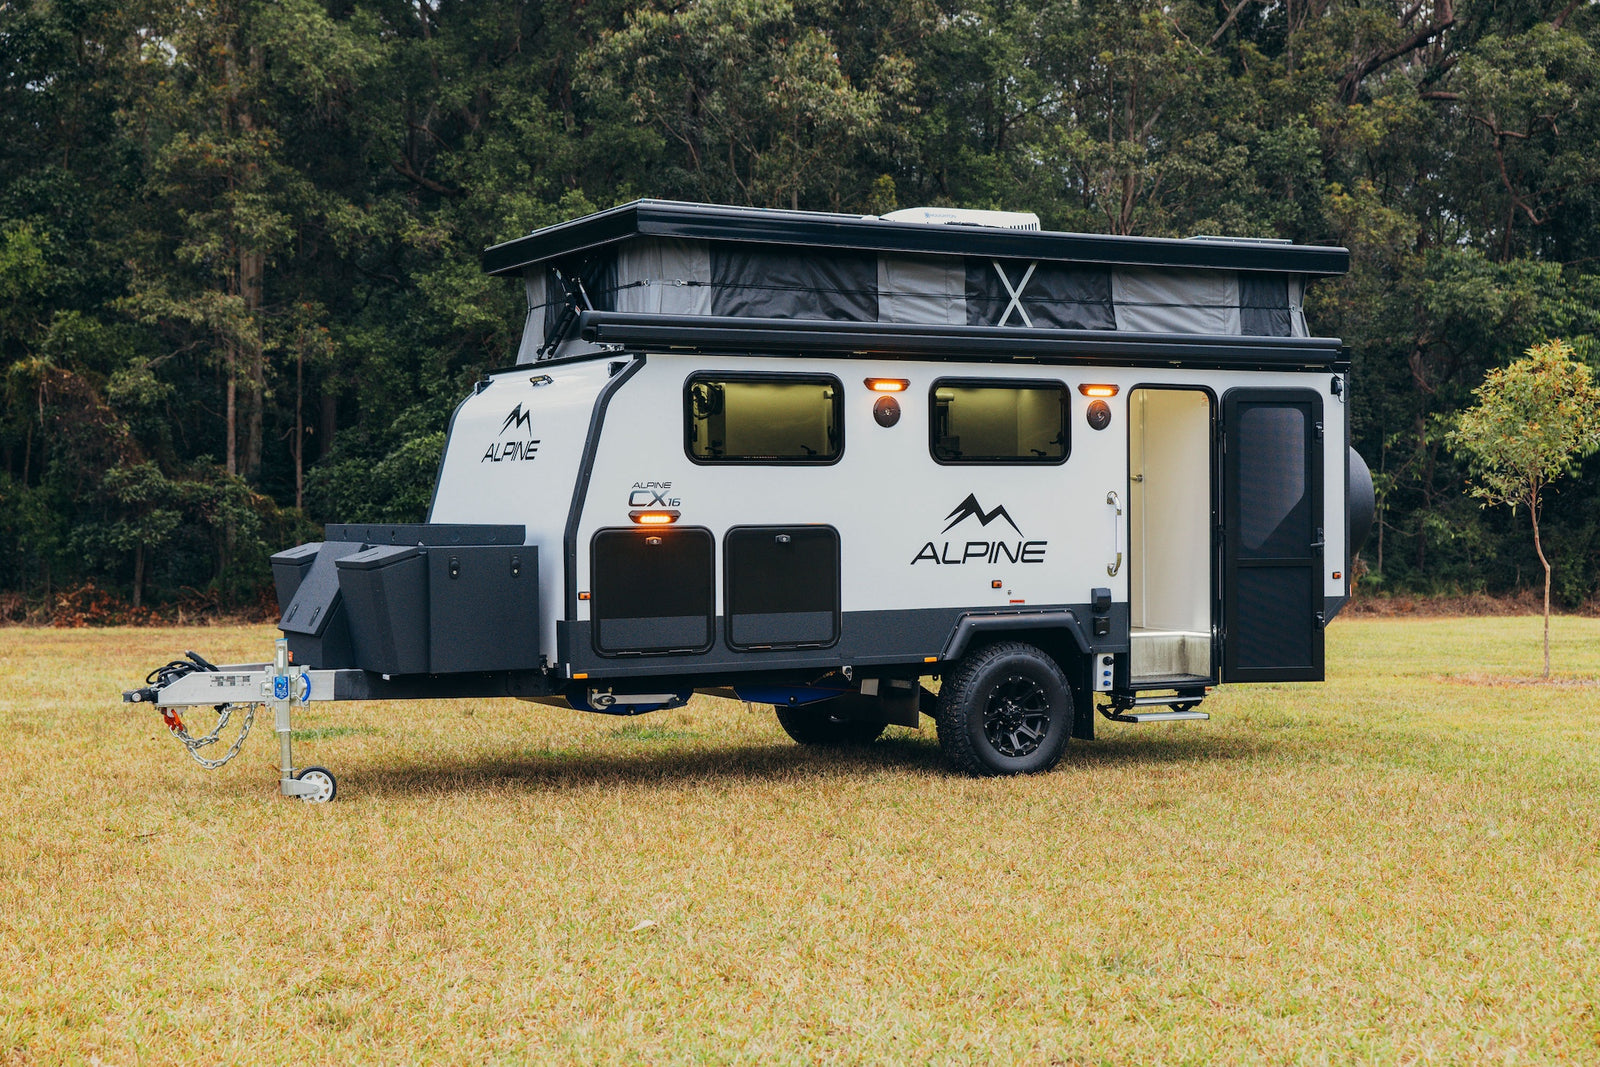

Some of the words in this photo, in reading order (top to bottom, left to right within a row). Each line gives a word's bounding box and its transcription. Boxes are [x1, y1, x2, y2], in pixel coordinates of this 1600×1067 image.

[481, 440, 541, 463] ALPINE
[631, 481, 672, 489] ALPINE
[910, 541, 1048, 565] ALPINE
